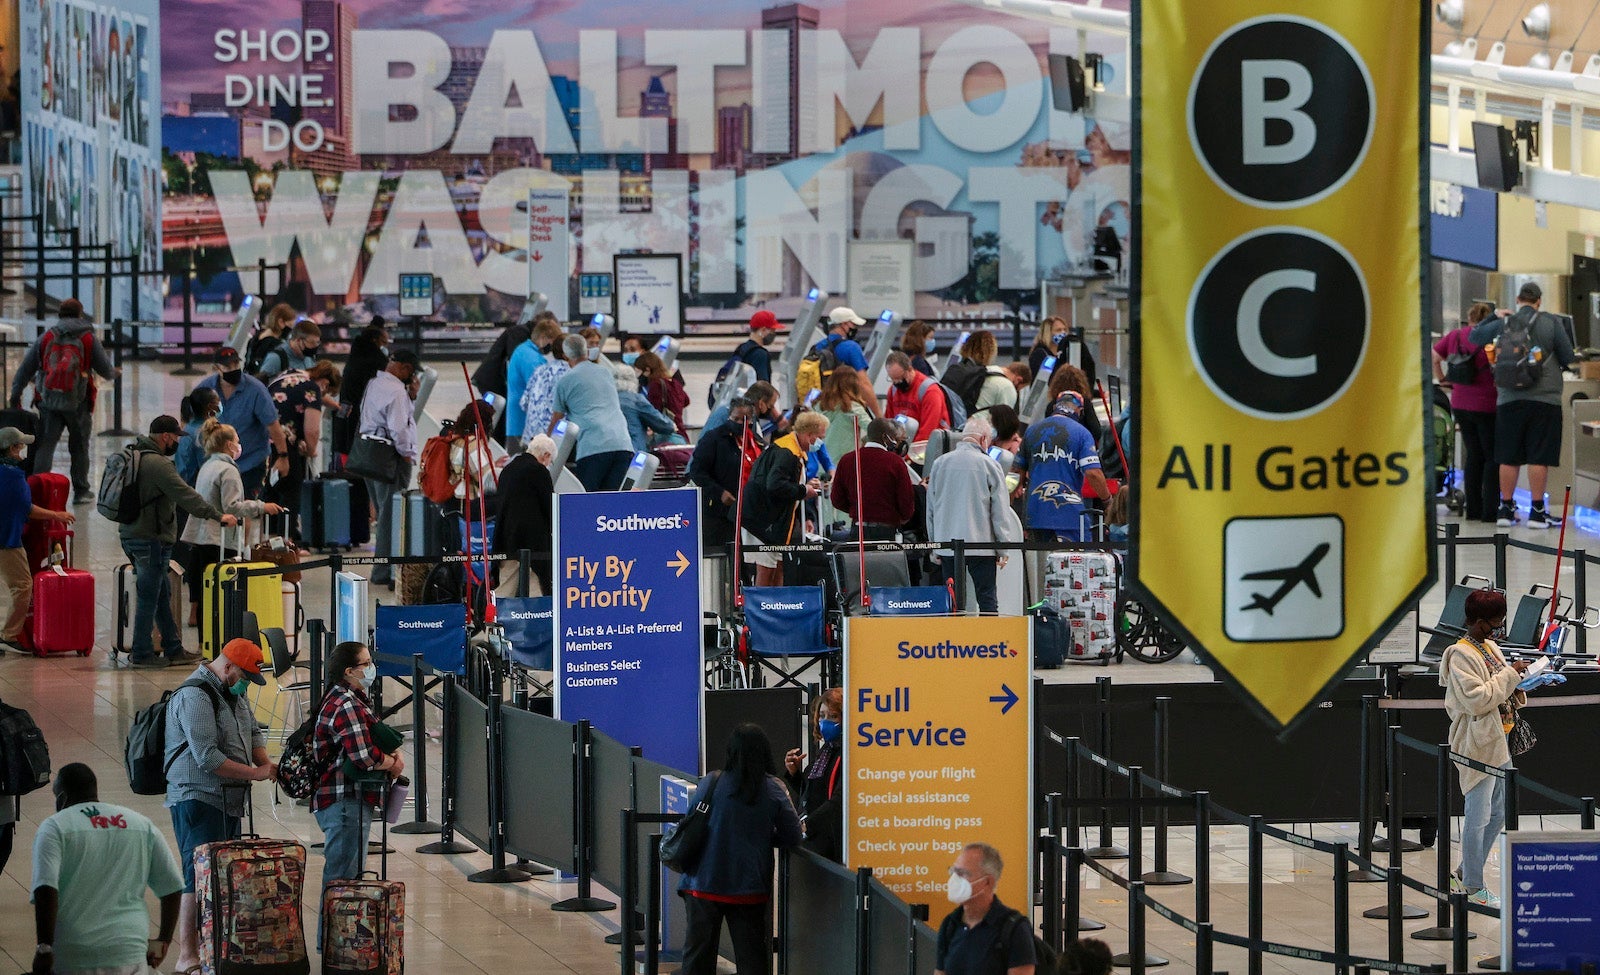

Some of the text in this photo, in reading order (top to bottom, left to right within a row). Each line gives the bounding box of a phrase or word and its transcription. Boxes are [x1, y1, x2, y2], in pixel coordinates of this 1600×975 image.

[213, 28, 334, 63] SHOP.
[224, 74, 335, 108] DINE.
[351, 24, 1132, 155] BALTIMOR
[1240, 58, 1318, 166] B
[262, 118, 335, 153] DO.
[531, 215, 566, 226] Tagging
[1235, 268, 1319, 378] C
[1156, 443, 1410, 492] All Gates
[596, 513, 682, 532] Southwest
[797, 544, 824, 552] AIRLINES
[914, 542, 942, 550] AIRLINES
[442, 553, 508, 563] SOUTHWST ALINES
[566, 555, 634, 585] Fly By
[566, 583, 652, 612] Priority
[887, 600, 932, 610] Southwest
[760, 601, 804, 611] Southwest
[510, 609, 553, 620] Southwest
[397, 619, 445, 630] Southwest
[565, 621, 683, 637] A-List & A-List Preferred
[565, 640, 613, 652] Members
[897, 640, 1008, 660] Southwest
[566, 659, 641, 673] Business Select
[566, 676, 618, 688] Customers
[858, 687, 910, 713] Full
[857, 720, 967, 748] Service
[857, 766, 976, 783] Change your flight
[857, 791, 971, 807] Special assistance
[857, 815, 983, 830] Get a boarding pass
[857, 838, 963, 855] Check your bags
[1517, 854, 1598, 862] Your health and wellness
[858, 864, 929, 879] grade to
[1517, 863, 1523, 871] is
[1535, 864, 1548, 872] top
[1548, 863, 1575, 872] priority.
[885, 881, 949, 893] ness Selec
